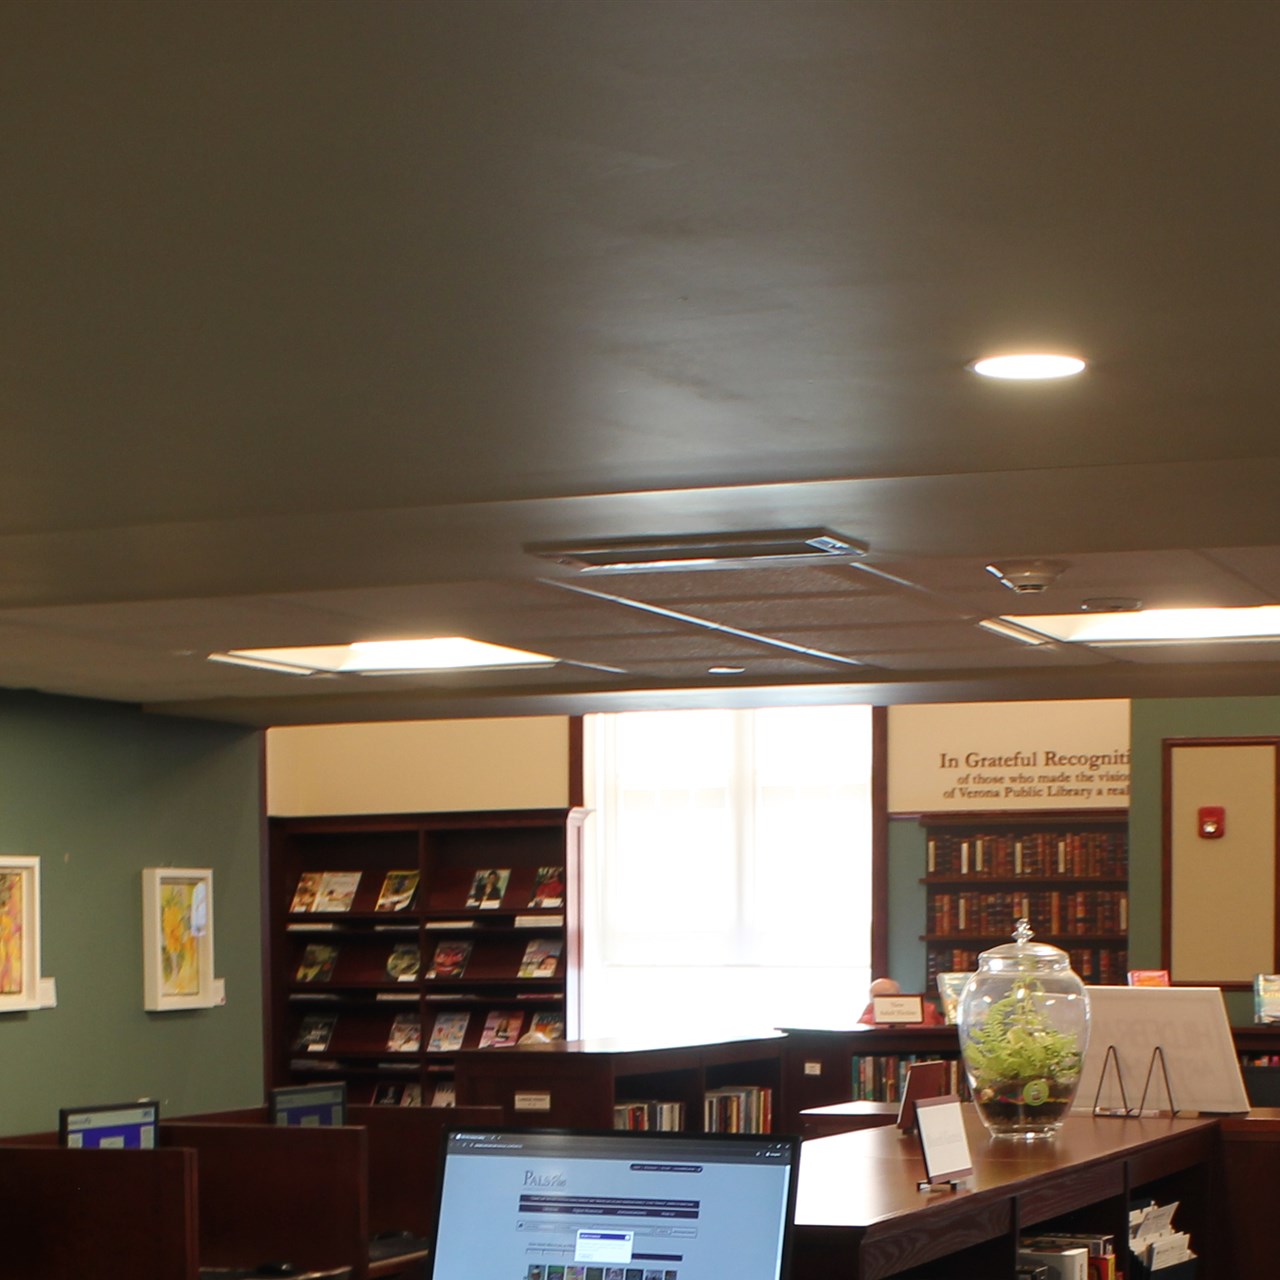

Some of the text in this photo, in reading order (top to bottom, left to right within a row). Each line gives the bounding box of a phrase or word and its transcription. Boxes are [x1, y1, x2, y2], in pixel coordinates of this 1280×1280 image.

[940, 754, 958, 768] In
[965, 751, 1037, 768] Grateful
[957, 773, 970, 785] of
[973, 773, 1005, 784] those
[1009, 773, 1034, 784] who
[1038, 772, 1071, 783] made
[1075, 771, 1094, 782] the
[943, 788, 957, 799] of
[959, 787, 1000, 799] Verona
[1004, 786, 1043, 798] Public
[1047, 785, 1093, 799] Library
[1096, 788, 1103, 796] a
